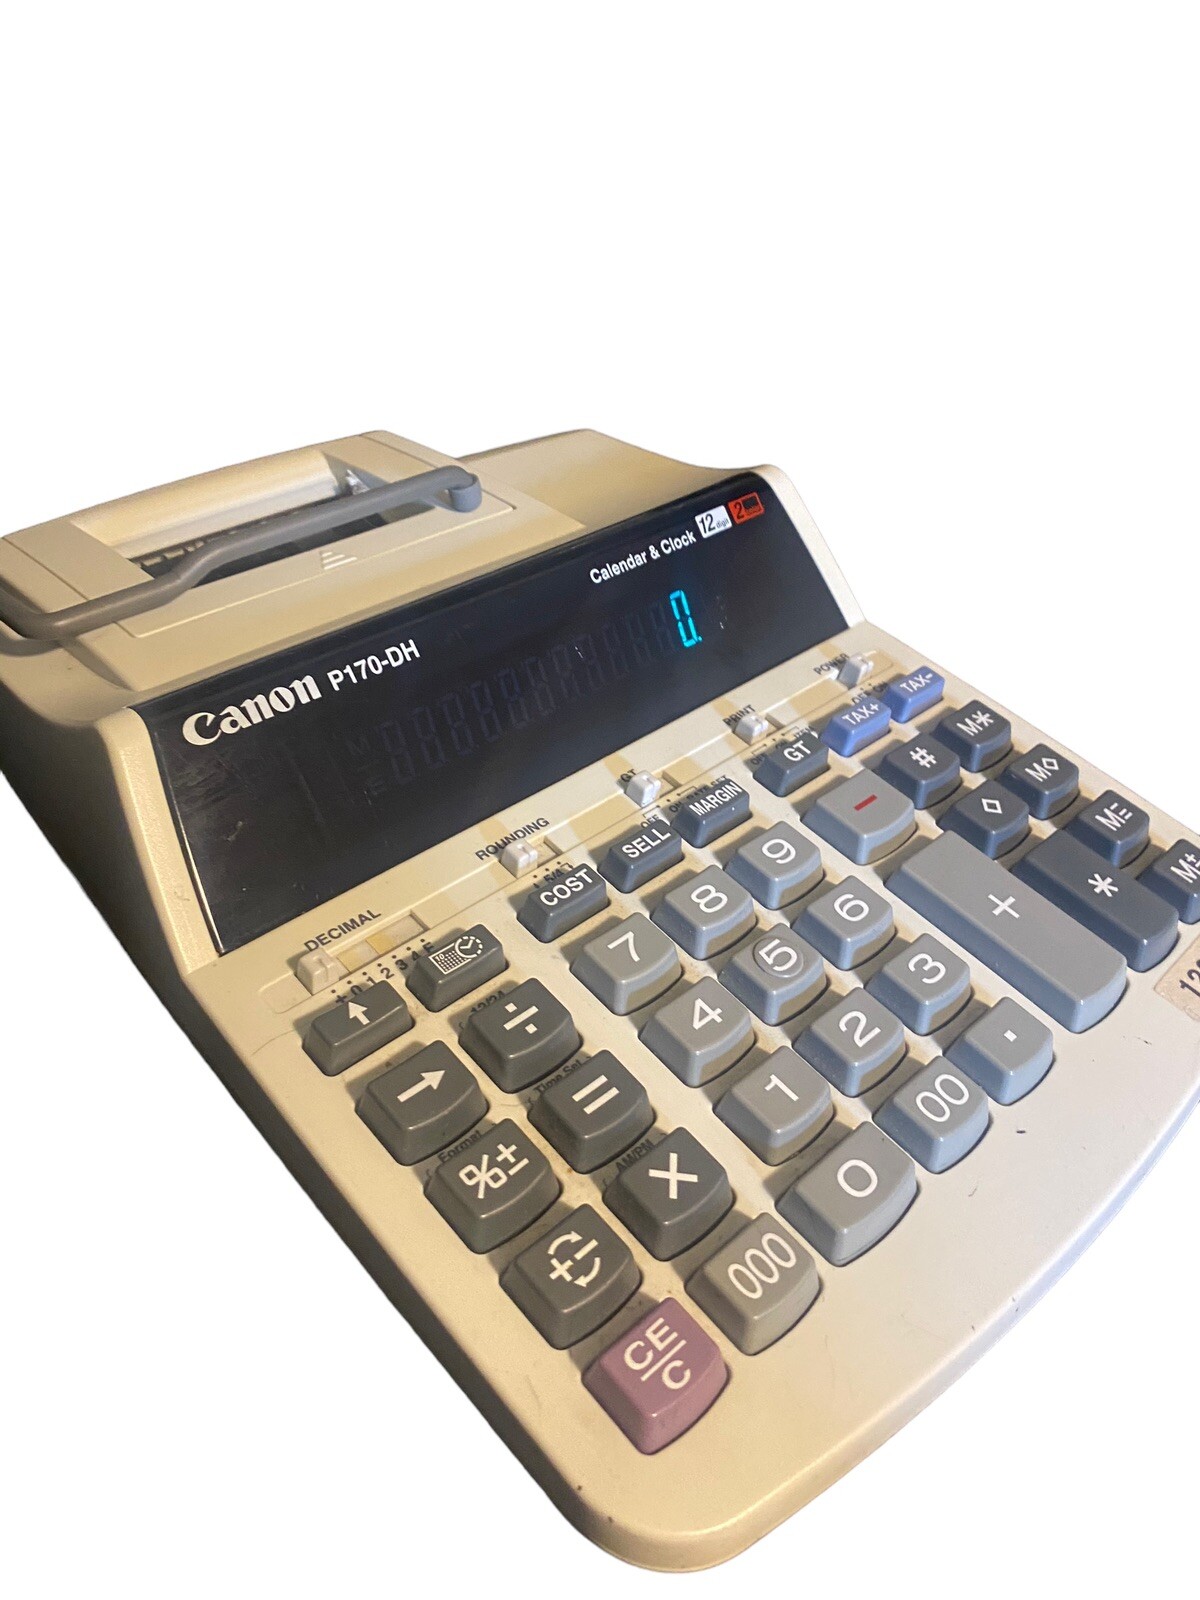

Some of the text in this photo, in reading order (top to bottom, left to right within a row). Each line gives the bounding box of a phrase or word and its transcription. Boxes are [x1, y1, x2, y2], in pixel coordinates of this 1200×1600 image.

[699, 513, 716, 535] 12
[589, 530, 697, 584] Calendar & Clock
[812, 653, 850, 676] POWER
[182, 638, 421, 746] Canon P170-DH
[722, 704, 756, 727] PRINT
[841, 702, 880, 726] TAX+
[783, 740, 812, 762] GT
[909, 746, 937, 769] #
[620, 768, 637, 784] GT
[688, 781, 743, 817] MARGIN
[475, 817, 551, 861] ROUNDING
[621, 826, 672, 859] SELL
[761, 838, 797, 865] 9
[539, 868, 594, 907] COST
[690, 884, 728, 914] 8
[833, 893, 870, 922] 6
[303, 908, 382, 952] DECIMAL
[607, 930, 642, 963] 7
[380, 967, 395, 980] 2
[395, 958, 409, 972] 3
[758, 938, 798, 972] 5
[907, 952, 947, 985] 3
[692, 997, 723, 1031] 4
[838, 1010, 882, 1048] 2
[764, 1073, 800, 1102] 1
[915, 1073, 970, 1123] 00
[836, 1158, 879, 1198] 0
[727, 1232, 797, 1300] 000
